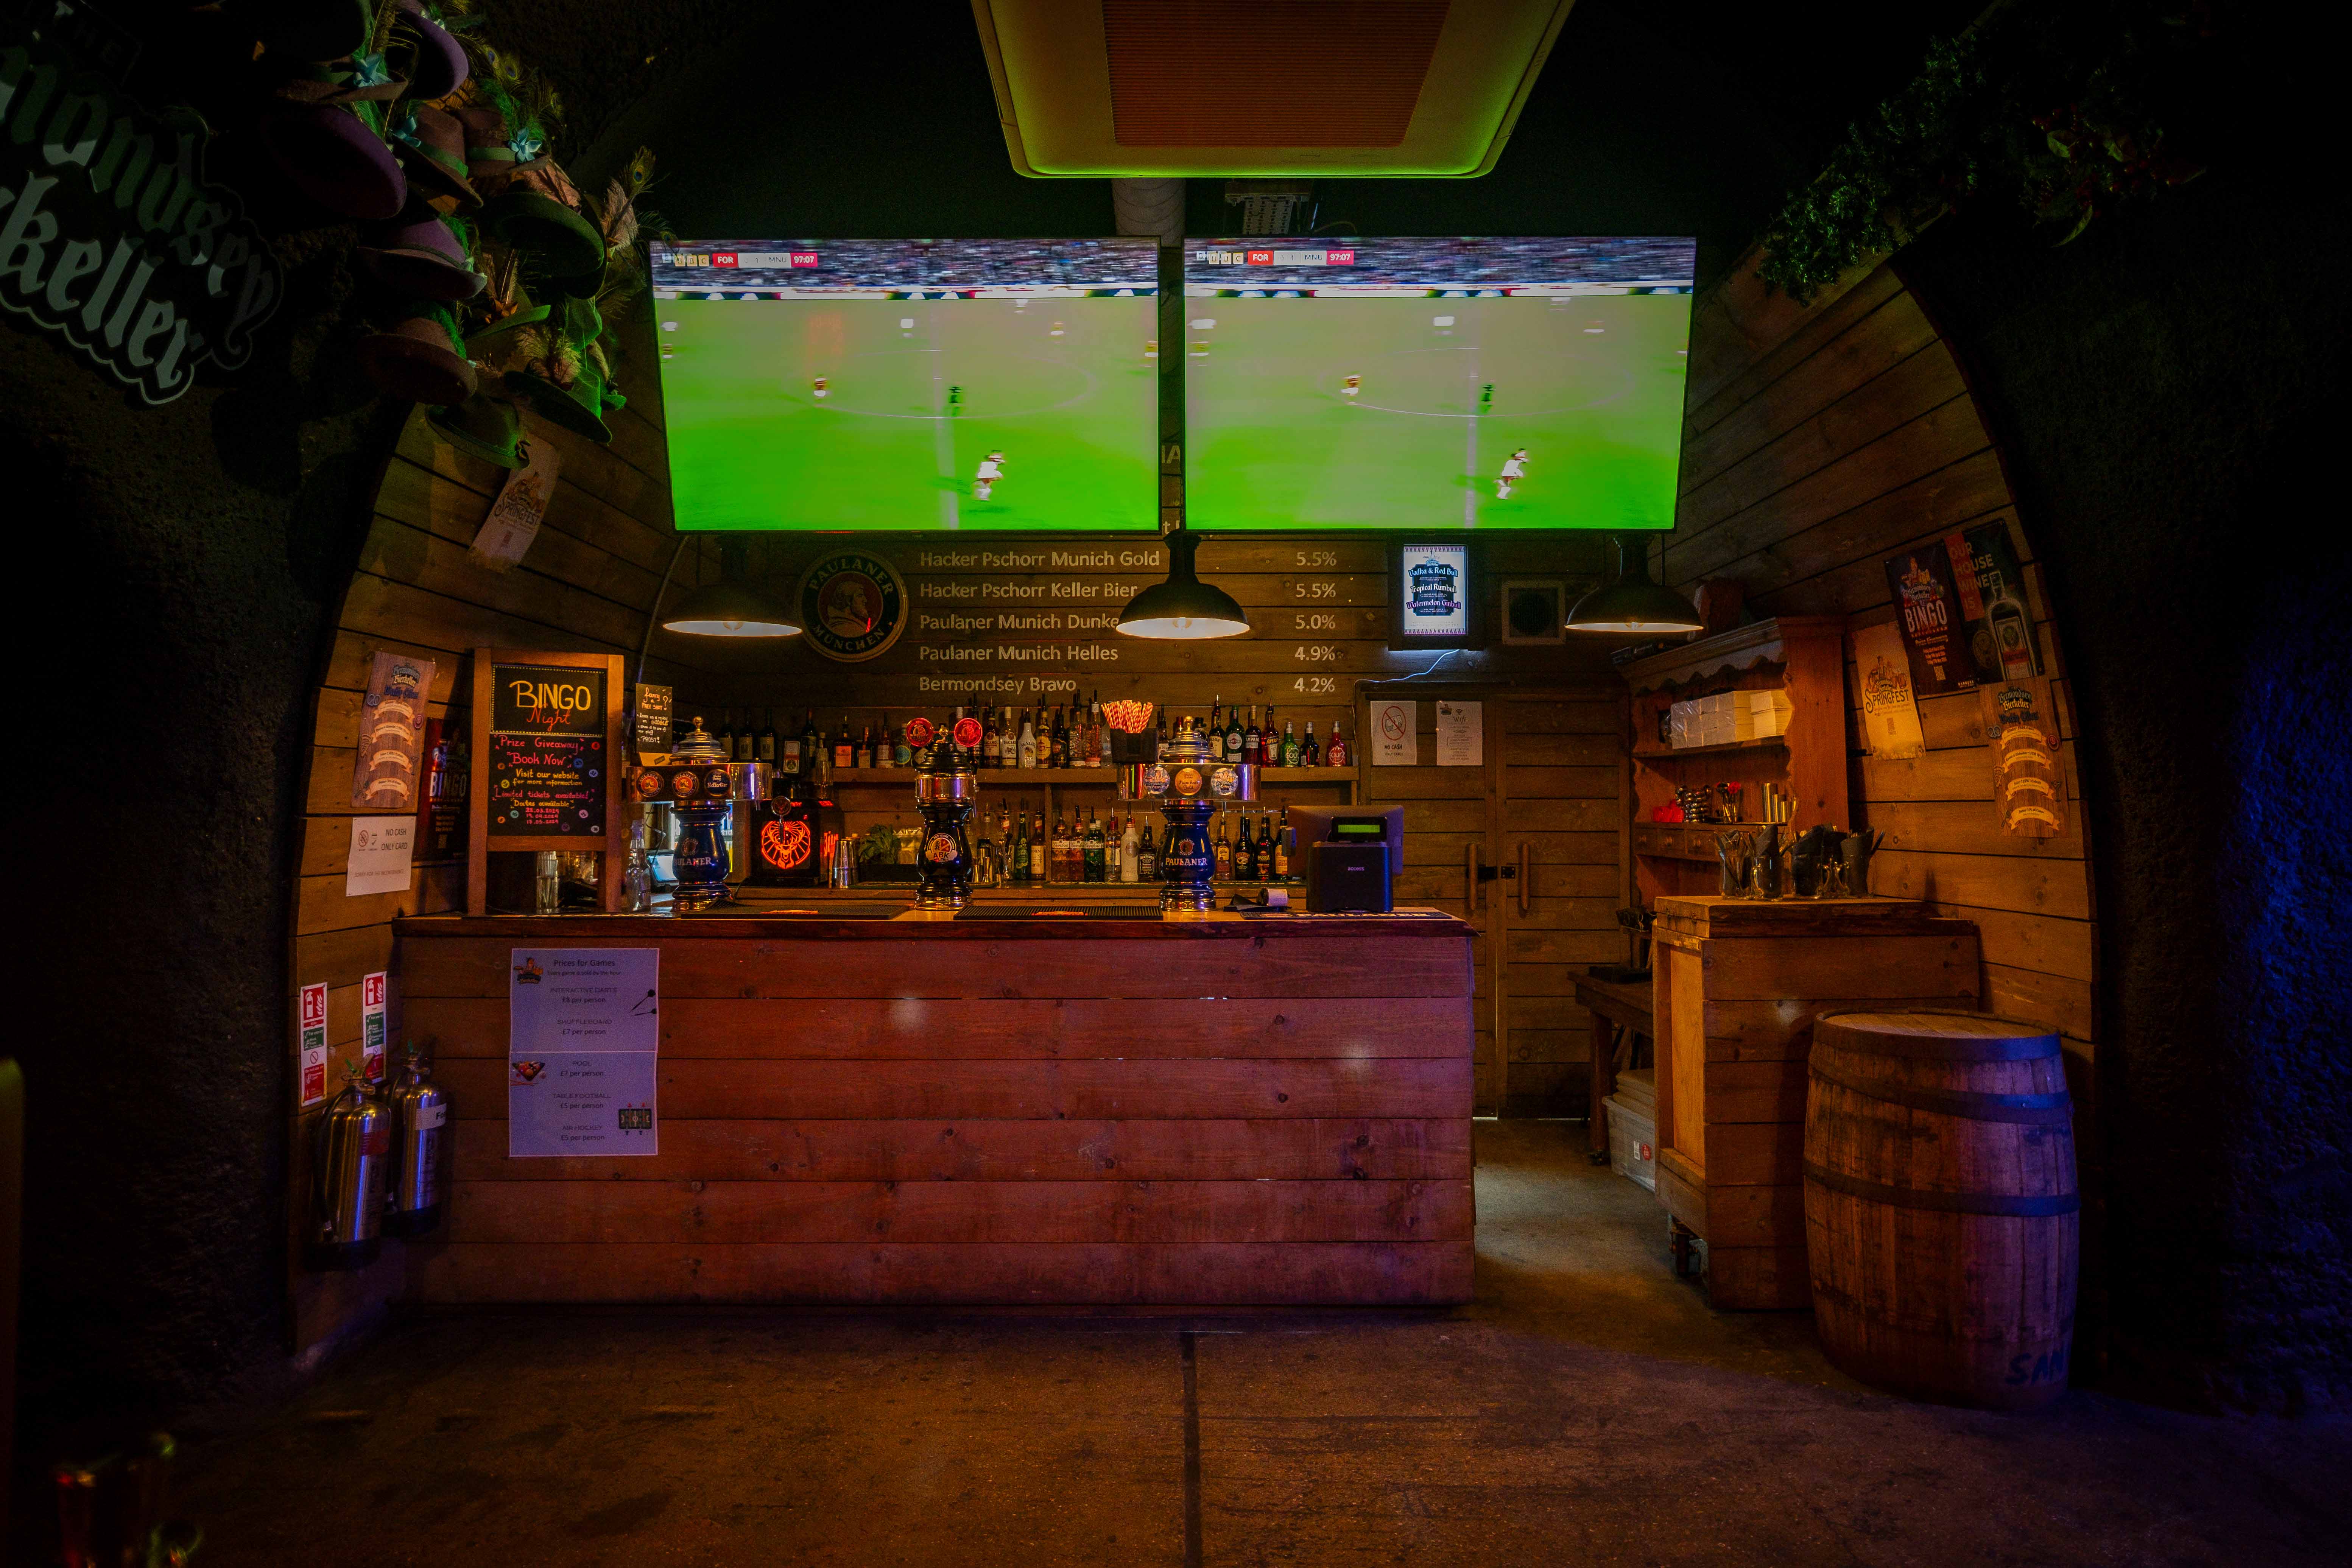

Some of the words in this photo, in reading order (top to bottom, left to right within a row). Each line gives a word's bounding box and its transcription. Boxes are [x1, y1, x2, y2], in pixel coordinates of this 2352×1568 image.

[0, 170, 206, 390] keller
[920, 551, 977, 566] Hacker
[983, 551, 1045, 566] Pschorr
[1051, 550, 1115, 566] Munich
[1120, 550, 1160, 566] Gold
[1296, 552, 1337, 566] 5.5%
[1955, 554, 1994, 575] HOUSE
[807, 558, 894, 595] PAULANER
[919, 583, 975, 598] Hacker
[982, 583, 1045, 598] Pschorr
[1051, 583, 1100, 598] Keller
[1104, 582, 1138, 597] Bier
[1296, 583, 1336, 598] 5.5%
[1411, 584, 1432, 593] Tropical
[1433, 584, 1456, 593] Rumbull
[1406, 599, 1440, 609] Watermelon
[1442, 599, 1461, 609] Ginbull
[919, 614, 993, 629] Paulaner
[998, 614, 1060, 629] Munich
[1067, 614, 1118, 629] Dunke
[1295, 615, 1336, 629] 5.0%
[1905, 599, 1947, 633] BINGO
[919, 646, 993, 661] Paulaner
[998, 646, 1060, 660] Munich
[1067, 645, 1118, 660] Helles
[1295, 646, 1335, 661] 4.9%
[919, 677, 1025, 694] Bermondsey
[1030, 676, 1076, 691] Bravo
[1294, 677, 1335, 693] 4.2%
[509, 680, 591, 710] BINGO
[1865, 689, 1909, 713] SPRINGFEST
[1998, 688, 2032, 703] Bermondsey
[2002, 699, 2029, 711] Bierkeller
[527, 707, 570, 732] Night
[499, 735, 525, 747] Prize
[535, 737, 579, 755] Giveaway
[511, 753, 539, 765] Book
[544, 754, 567, 766] Now
[516, 769, 533, 778] Visit
[553, 771, 580, 779] website
[429, 771, 467, 797] BINGO
[512, 778, 526, 787] for
[546, 779, 583, 787] information
[495, 787, 523, 798] Limited
[528, 790, 550, 799] tickets
